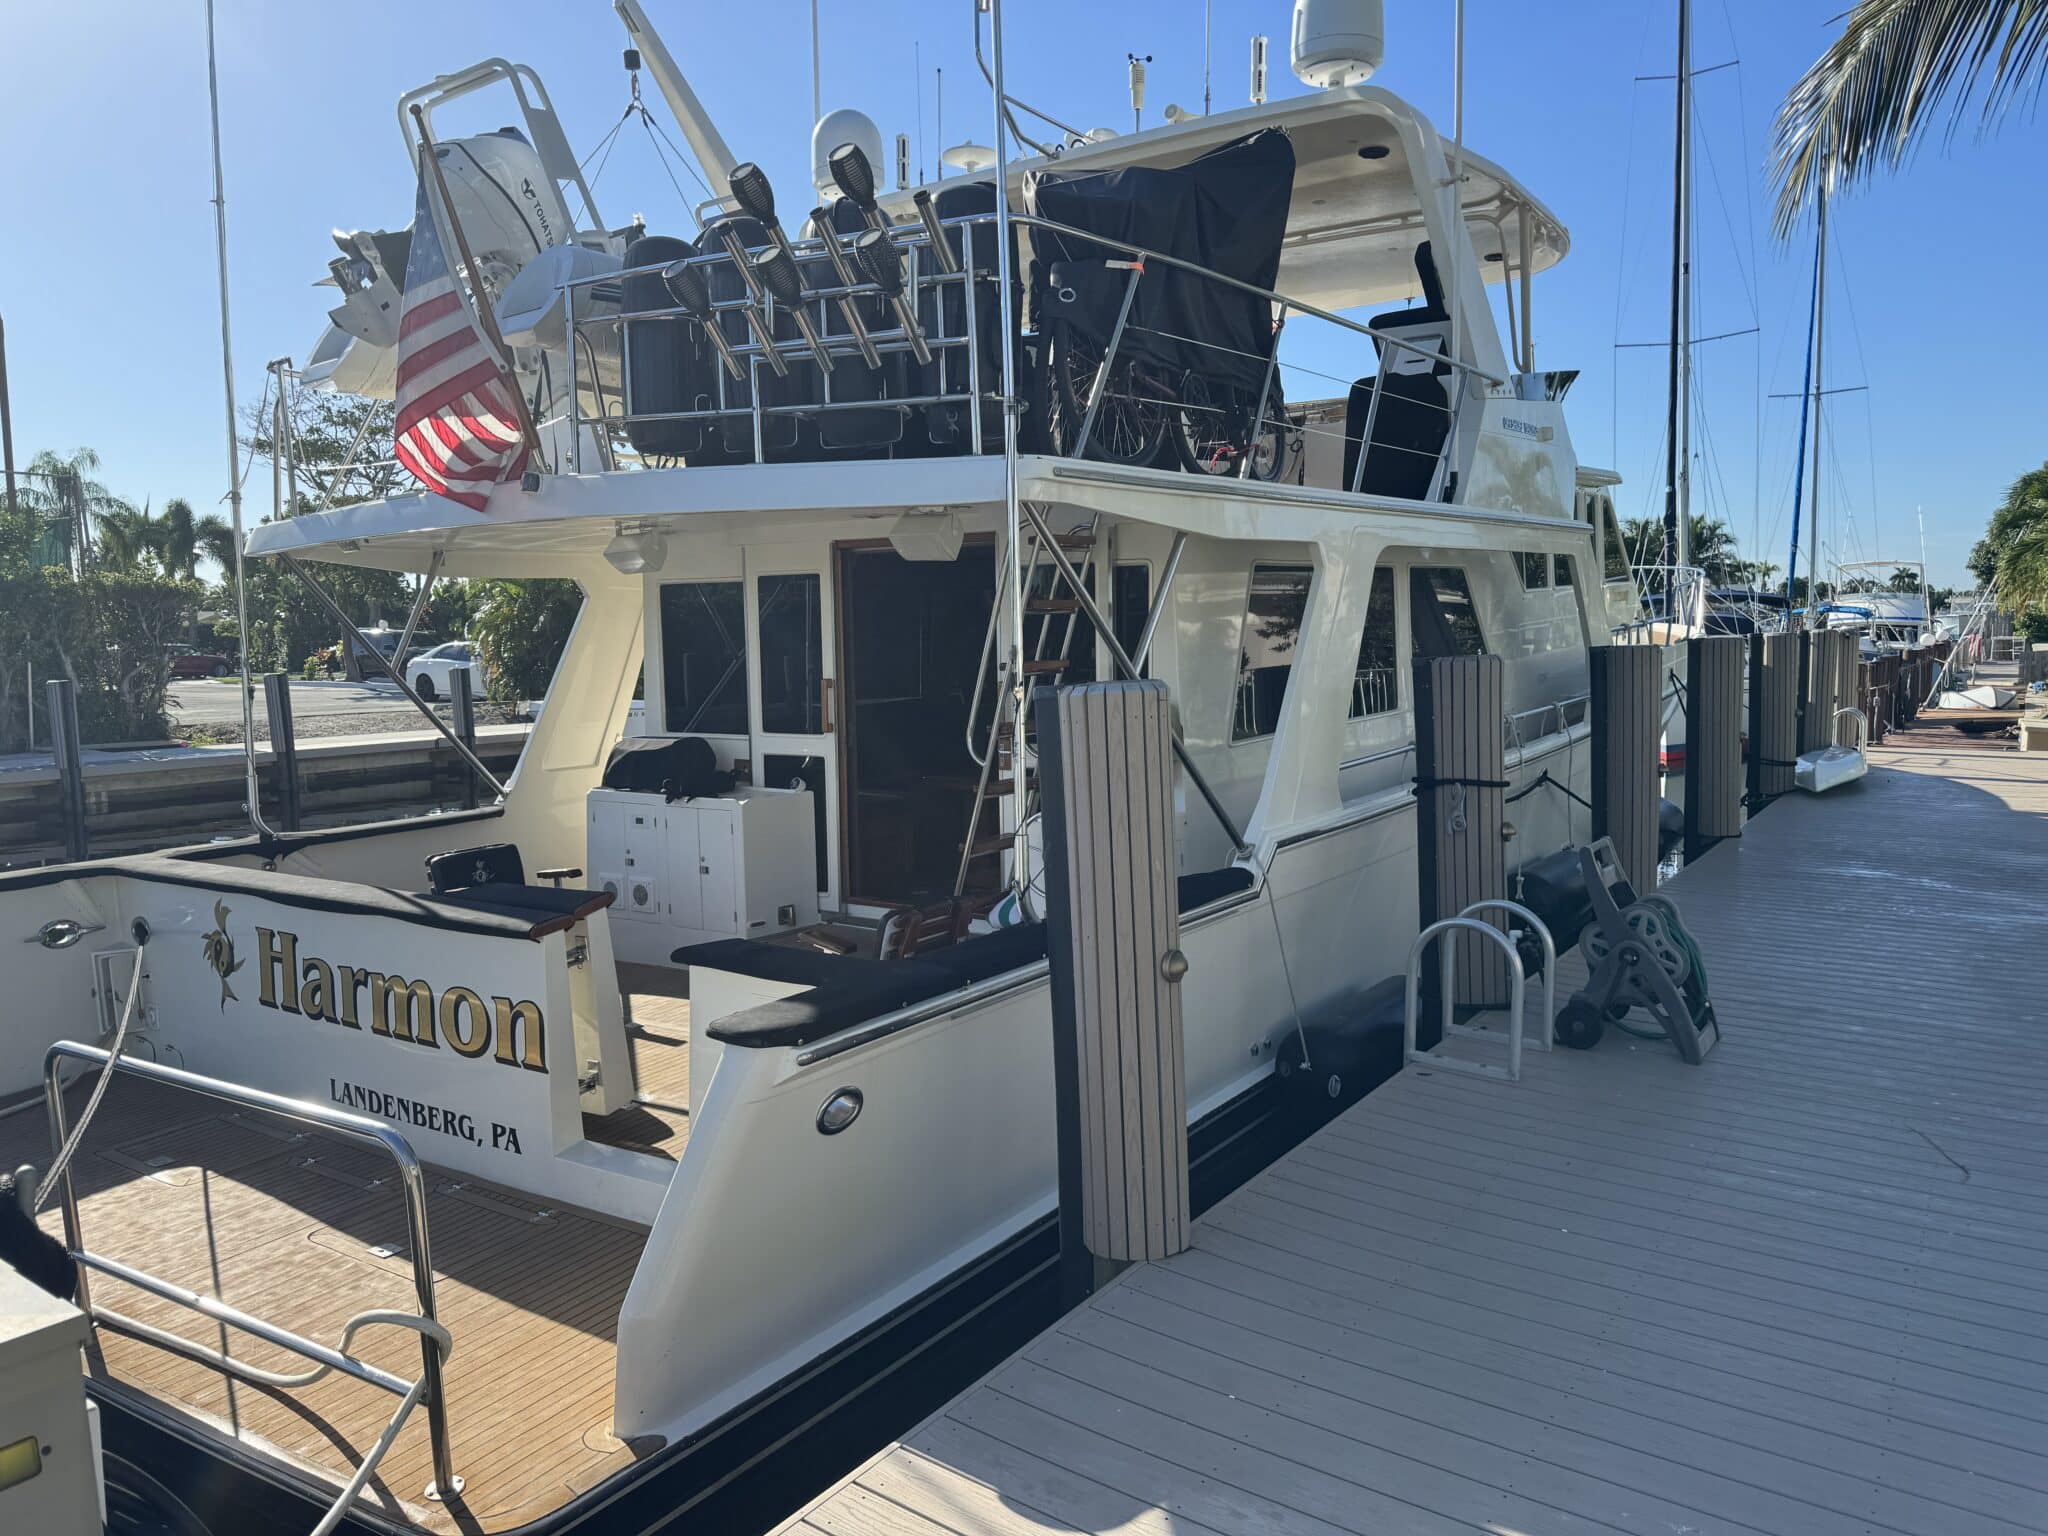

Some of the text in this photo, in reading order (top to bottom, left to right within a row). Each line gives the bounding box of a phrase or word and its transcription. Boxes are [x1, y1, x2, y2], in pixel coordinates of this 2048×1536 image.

[533, 199, 554, 249] TOHATS
[255, 926, 549, 1074] Harmon
[330, 1078, 522, 1155] LANDENBERG, PA
